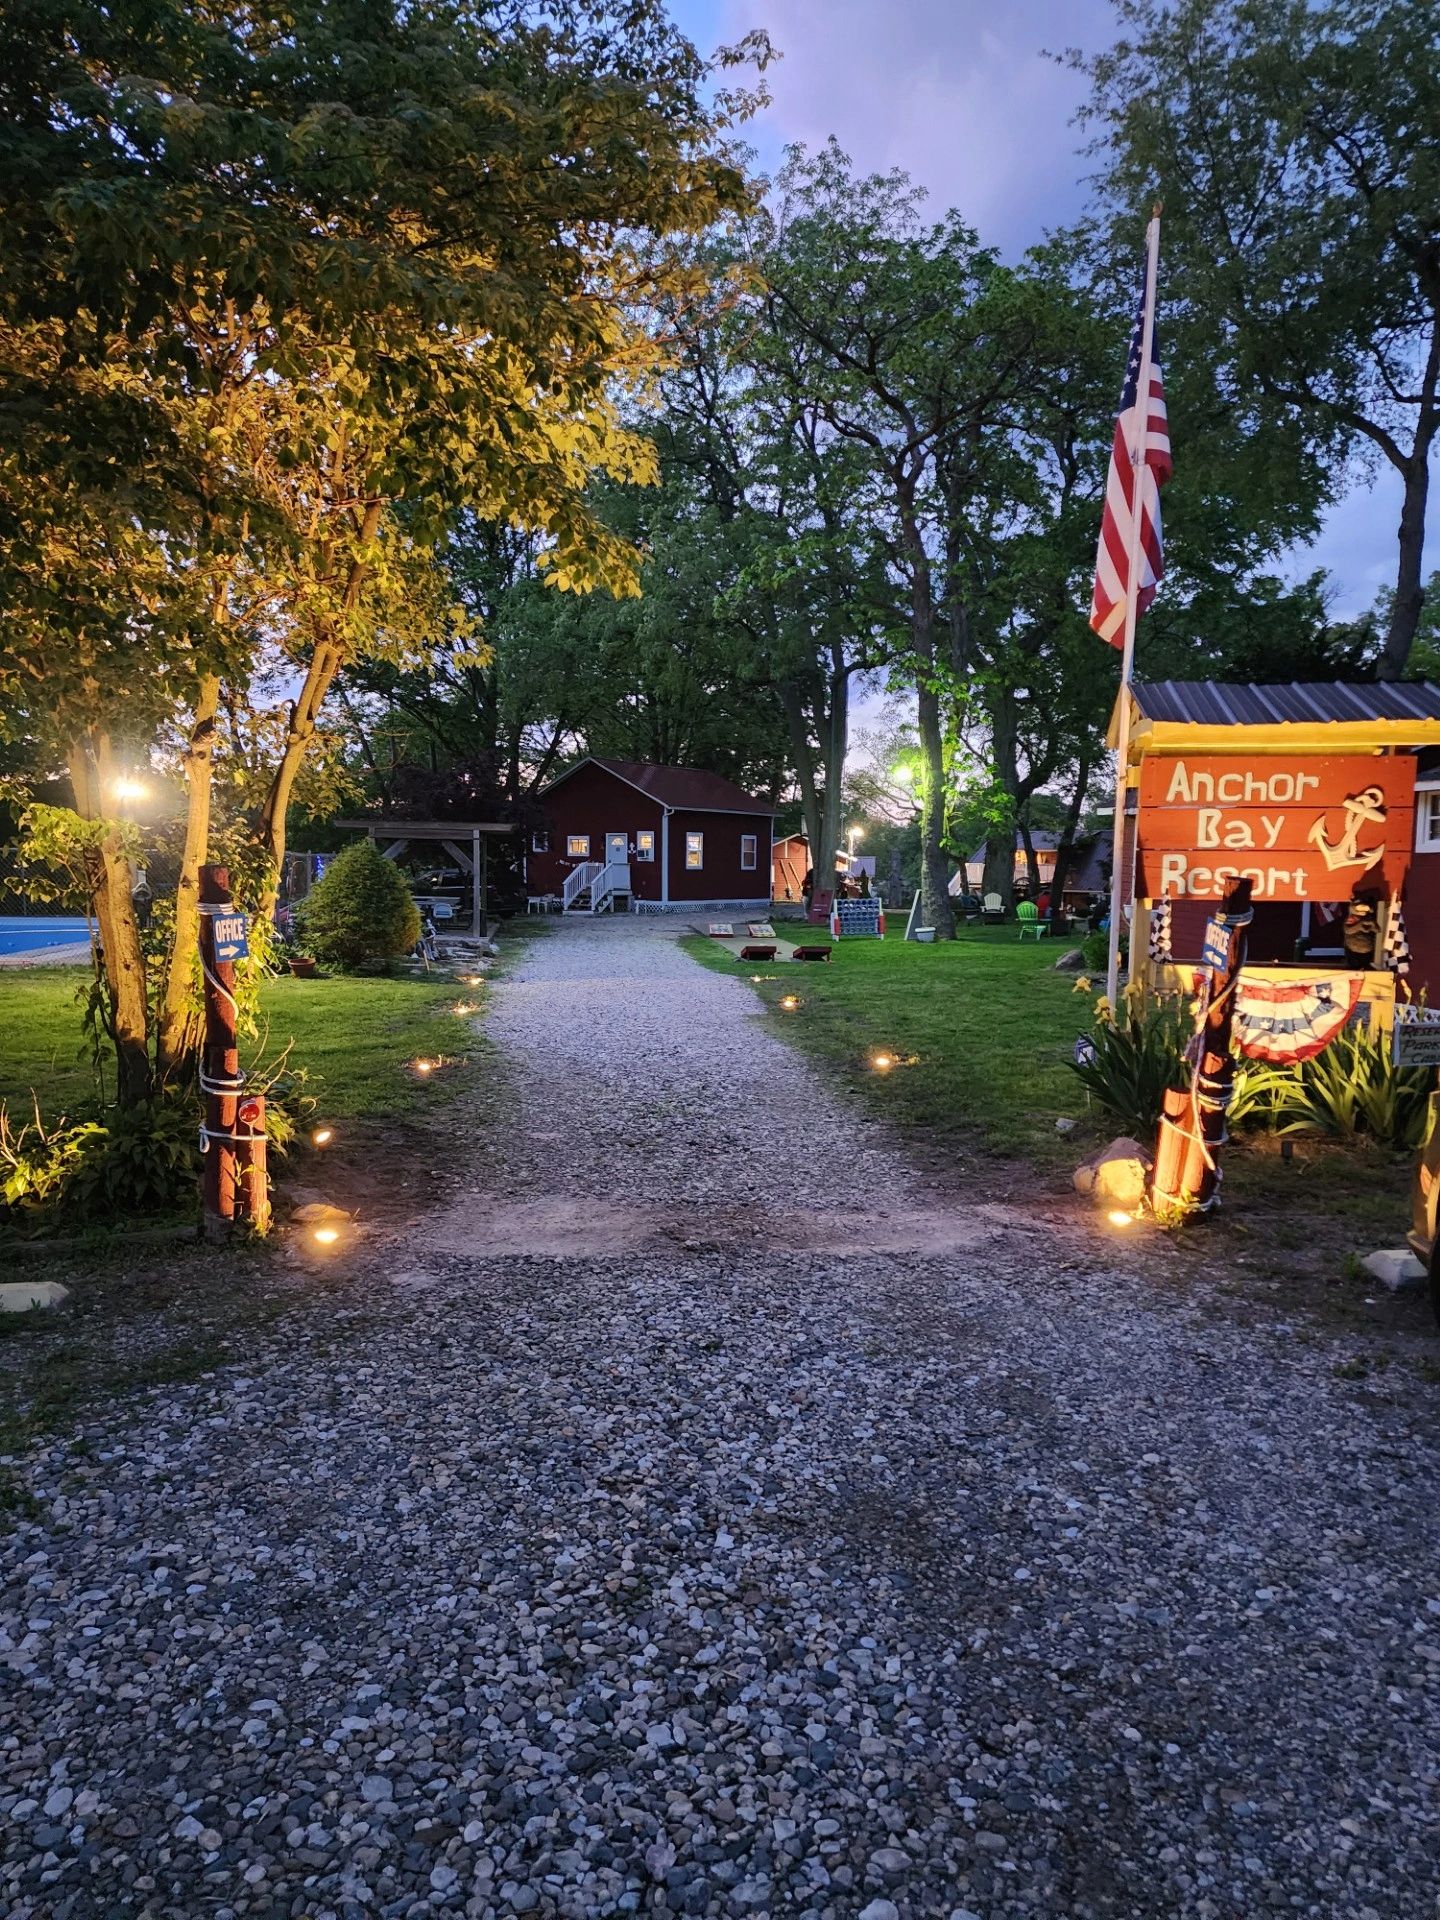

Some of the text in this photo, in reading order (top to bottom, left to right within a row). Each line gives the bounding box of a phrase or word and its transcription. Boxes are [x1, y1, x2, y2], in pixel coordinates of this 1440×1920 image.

[1166, 761, 1319, 802] Anchor
[1197, 808, 1285, 848] Bay
[1161, 854, 1308, 896] Resort
[215, 918, 244, 943] OFFICE
[1205, 922, 1230, 956] OFFICE
